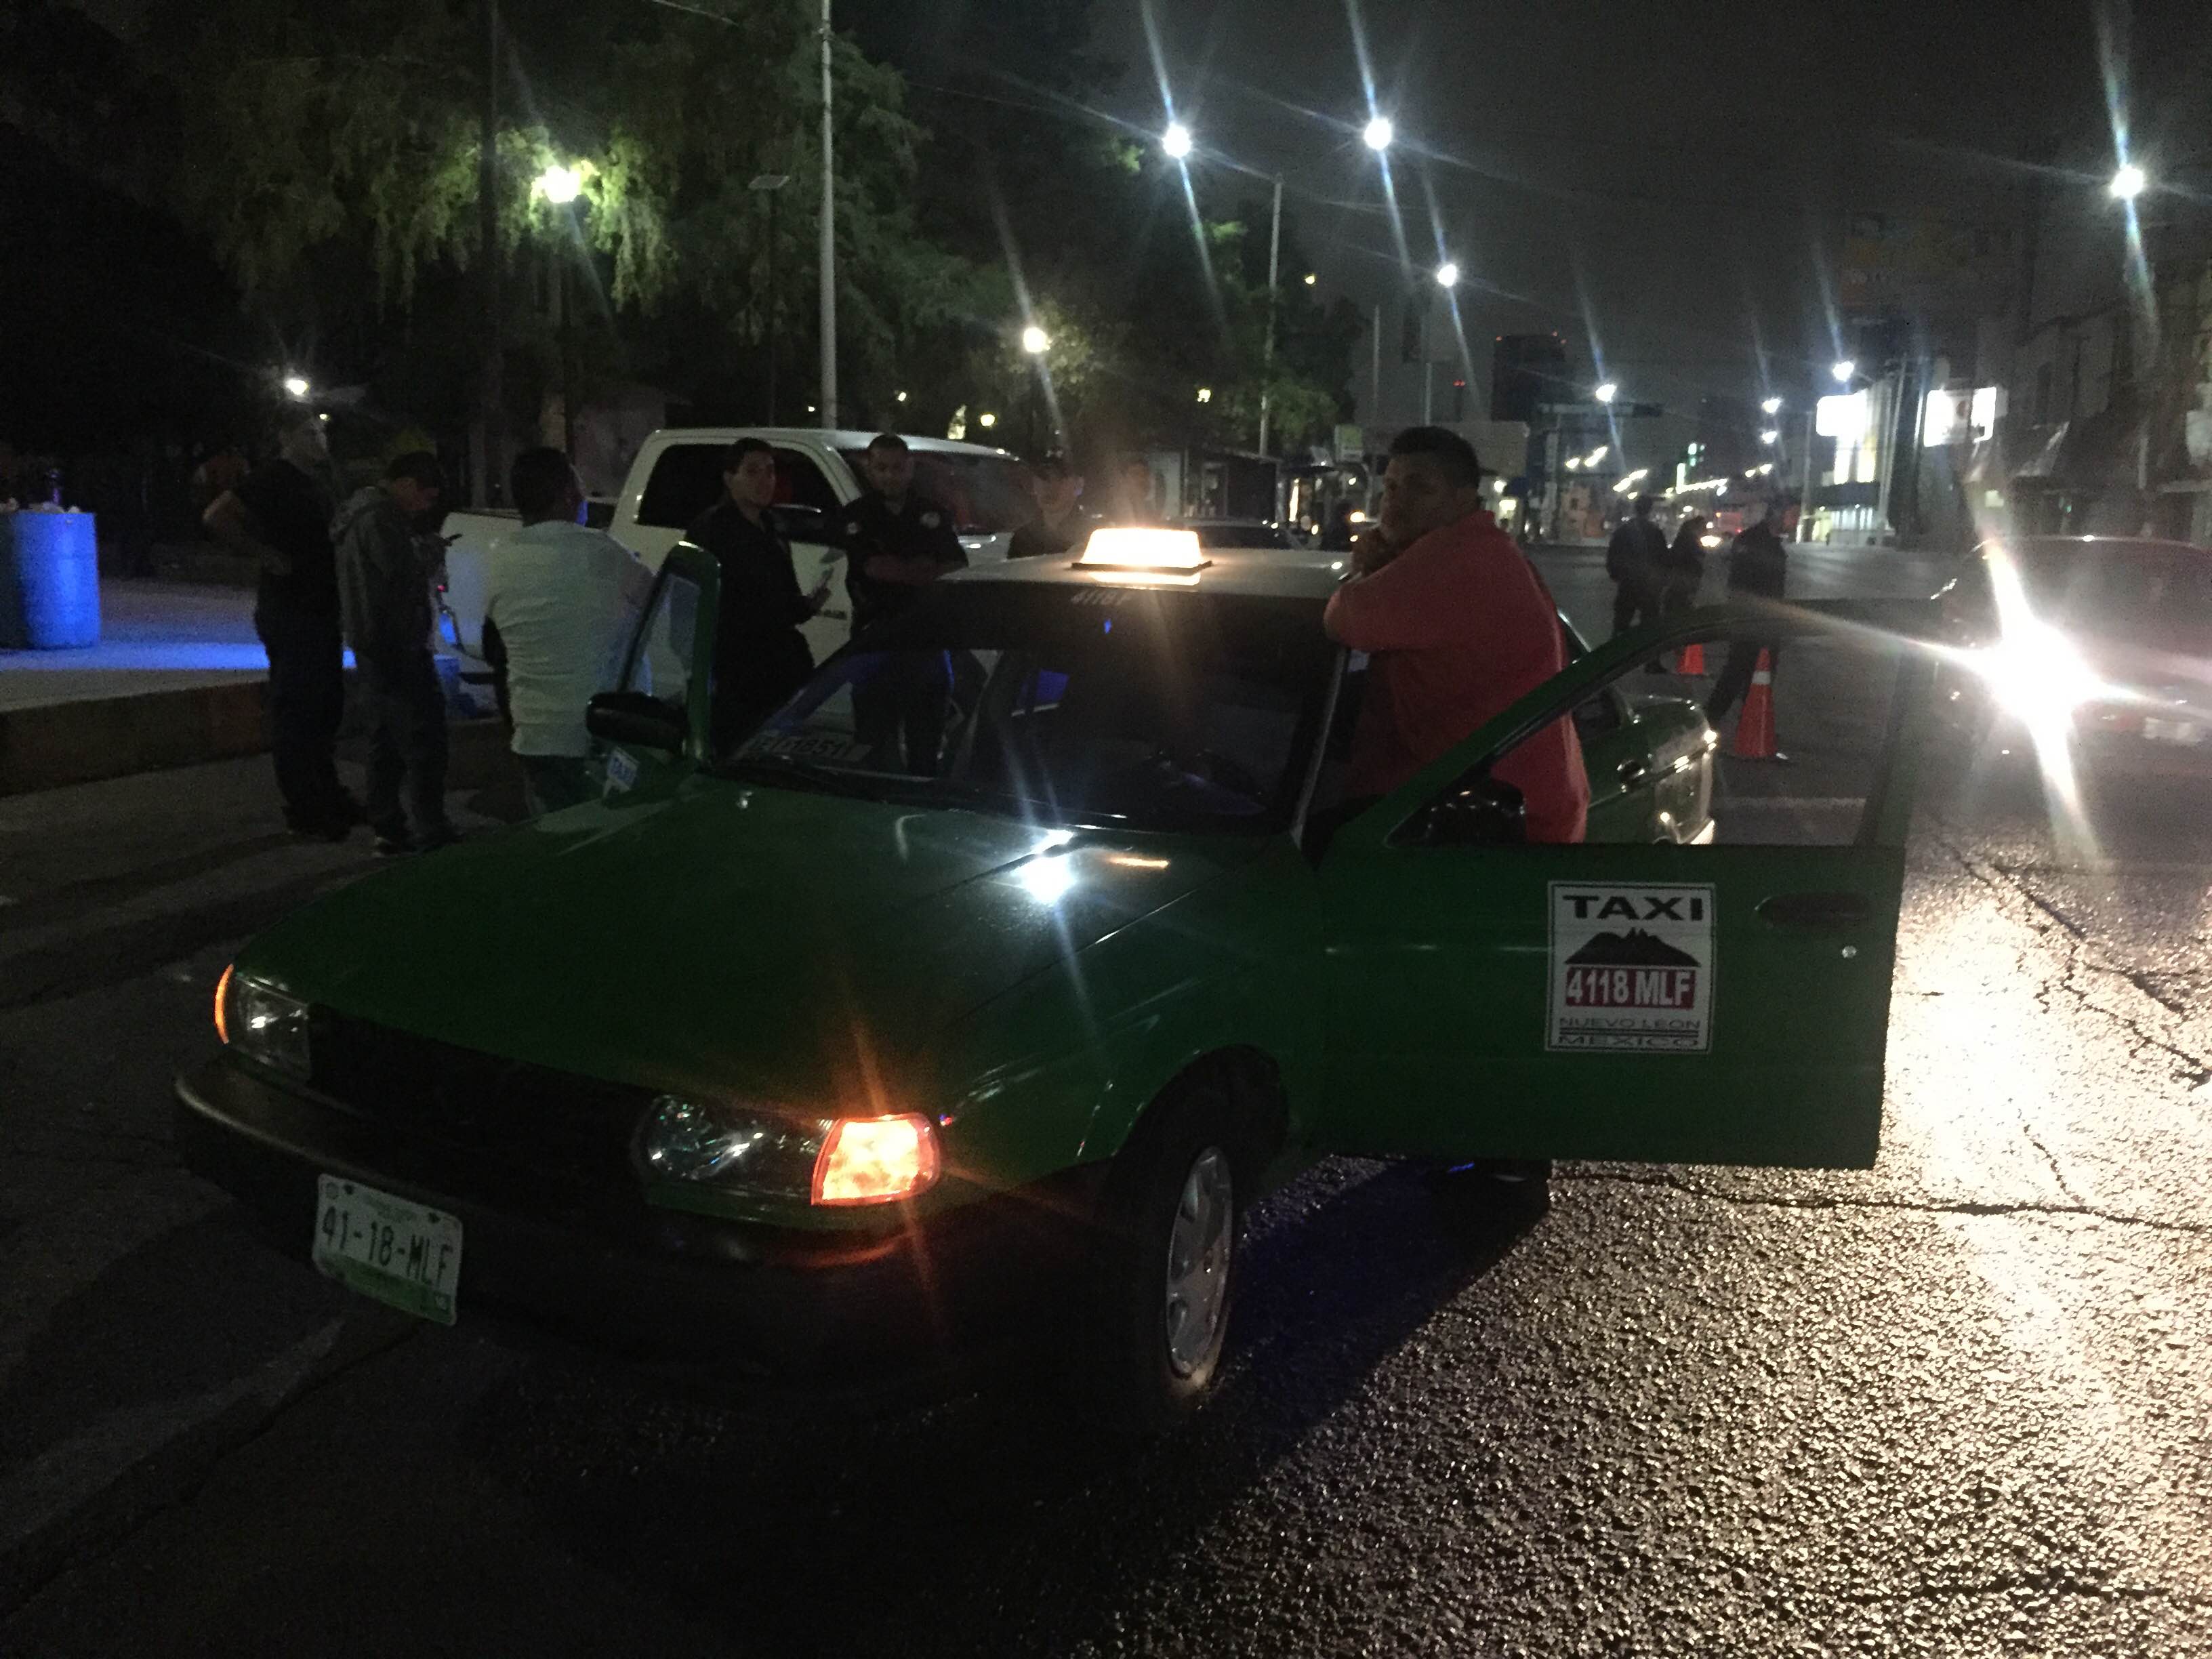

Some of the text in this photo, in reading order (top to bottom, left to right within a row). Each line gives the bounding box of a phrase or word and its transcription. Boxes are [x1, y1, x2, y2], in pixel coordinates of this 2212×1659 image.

[1563, 895, 1702, 921] TAXI
[1567, 968, 1692, 1006] 4118 MLF
[1559, 1018, 1700, 1029] NUEVO LEON
[1558, 1035, 1698, 1046] MEXICO
[323, 1206, 453, 1288] 41-18-MLF
